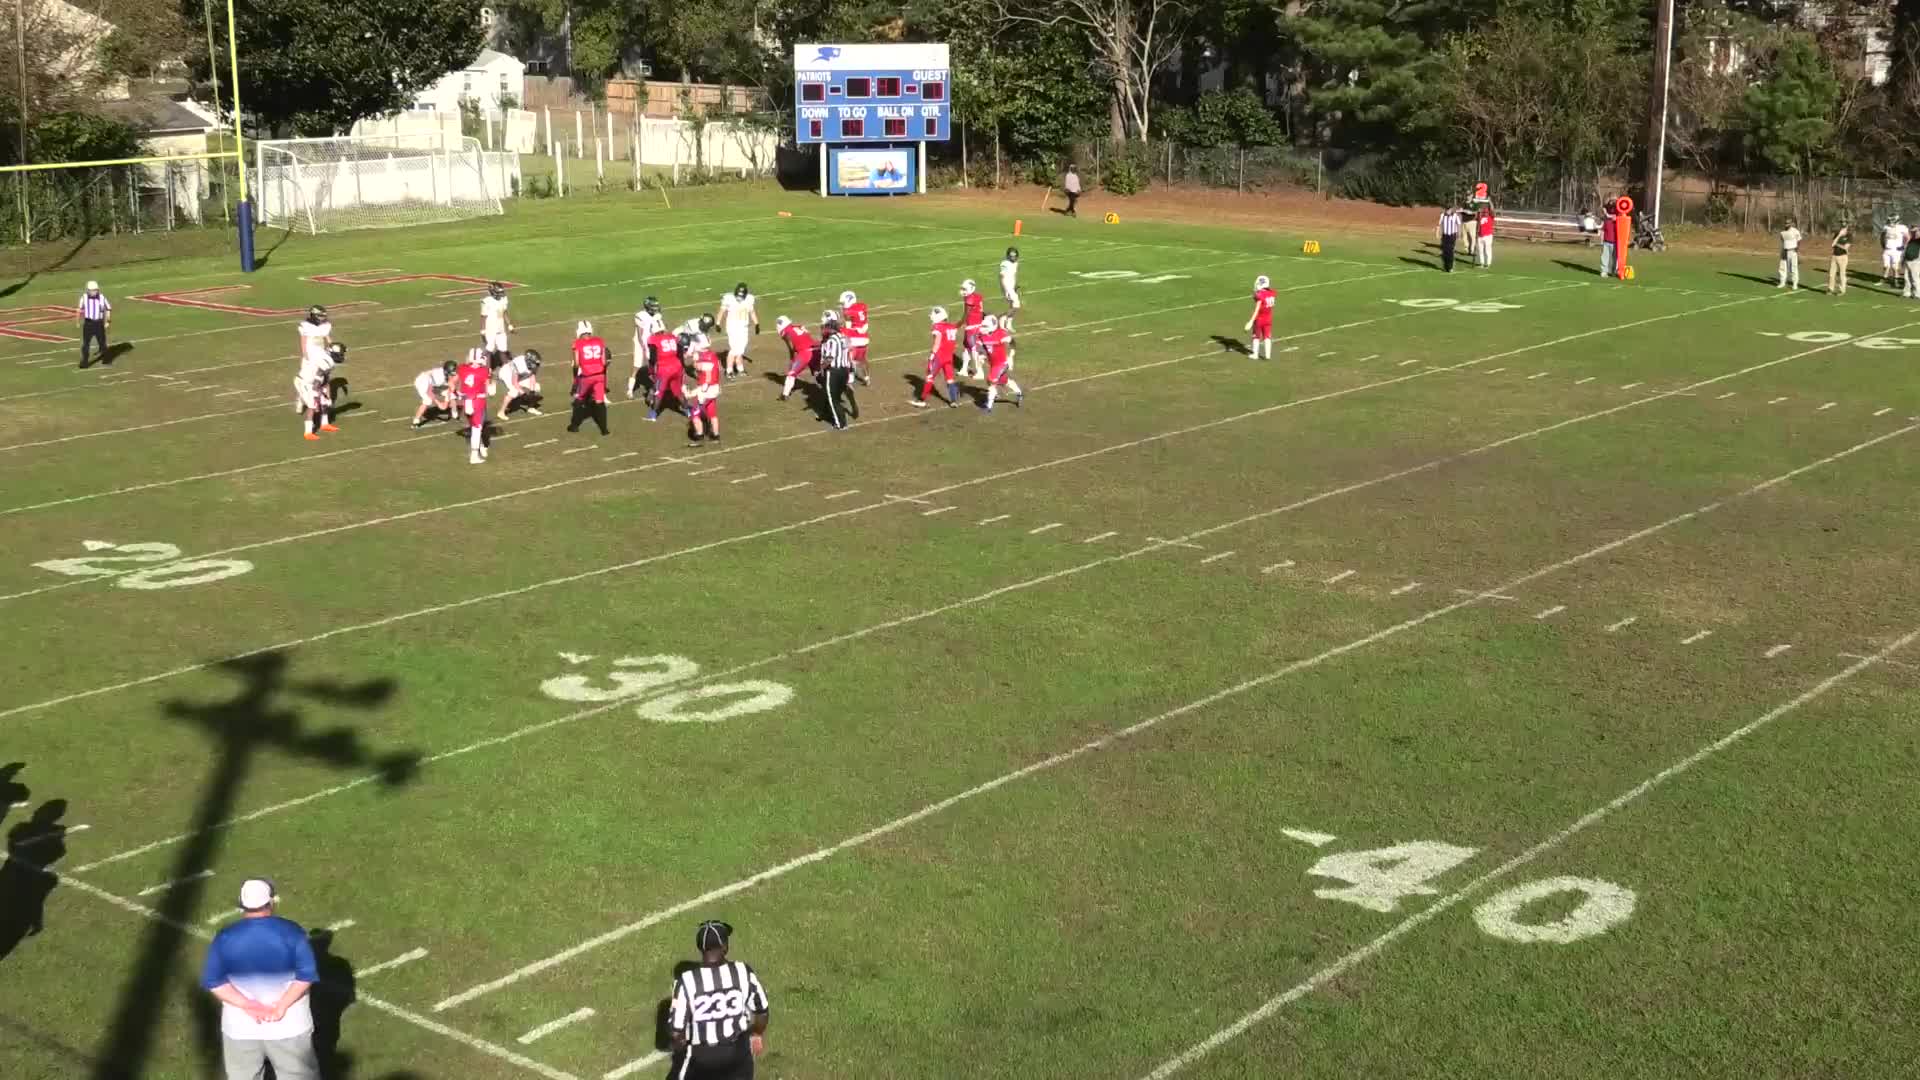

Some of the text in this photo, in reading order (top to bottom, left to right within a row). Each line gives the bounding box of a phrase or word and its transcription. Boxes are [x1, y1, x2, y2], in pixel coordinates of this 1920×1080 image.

[797, 72, 832, 82] PATRIOTS
[913, 70, 948, 81] GUEST
[801, 108, 829, 119] DOWN
[838, 107, 868, 118] TO GO
[877, 106, 914, 118] BALL ON
[1475, 182, 1488, 199] 2
[582, 344, 601, 359] 52
[464, 373, 475, 388] 4
[30, 541, 255, 590] 20
[539, 653, 794, 723] 30
[1307, 839, 1638, 944] 40
[693, 989, 743, 1022] 233
